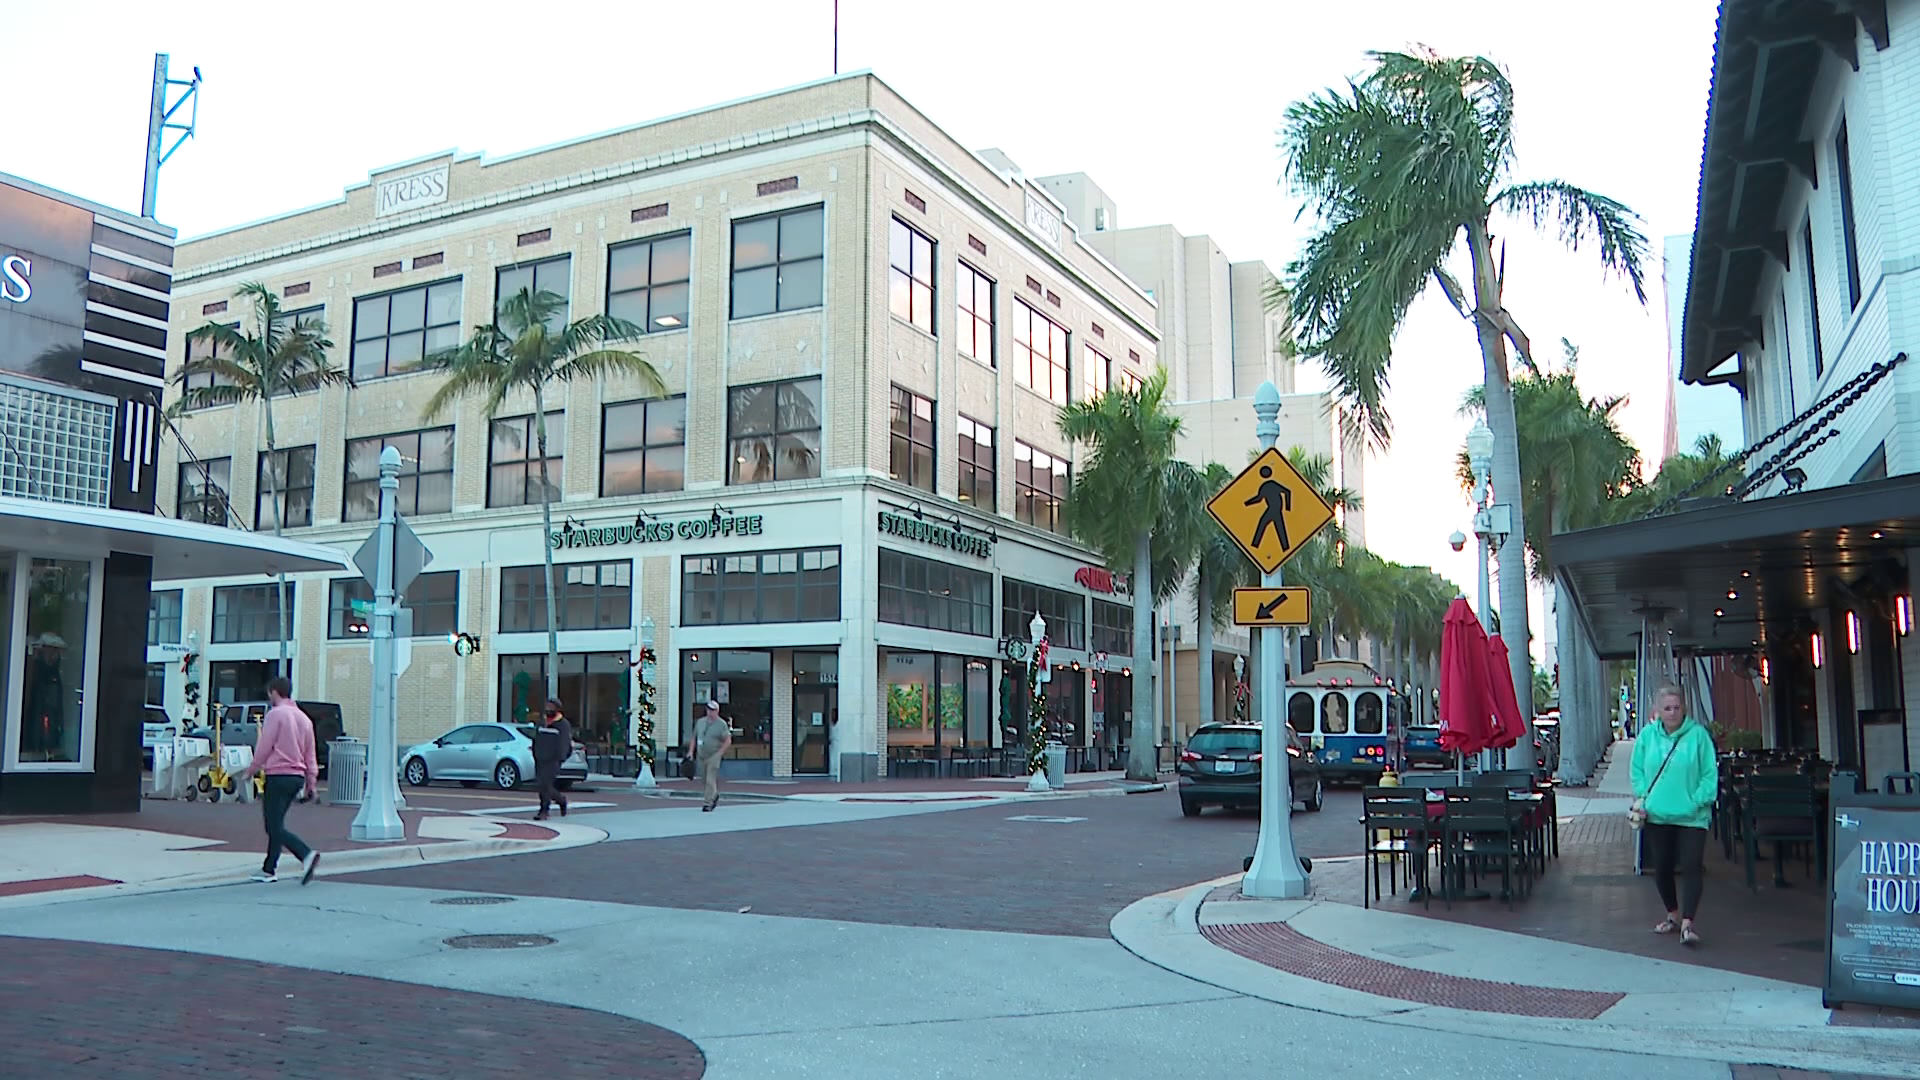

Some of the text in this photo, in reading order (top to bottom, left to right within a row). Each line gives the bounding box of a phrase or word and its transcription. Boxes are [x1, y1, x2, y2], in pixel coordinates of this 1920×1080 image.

[382, 172, 444, 211] KRESS
[551, 515, 763, 549] STARBUCKS COFFEE
[879, 511, 993, 558] STARBUCKS COFFEE
[1867, 878, 1920, 914] HOU
